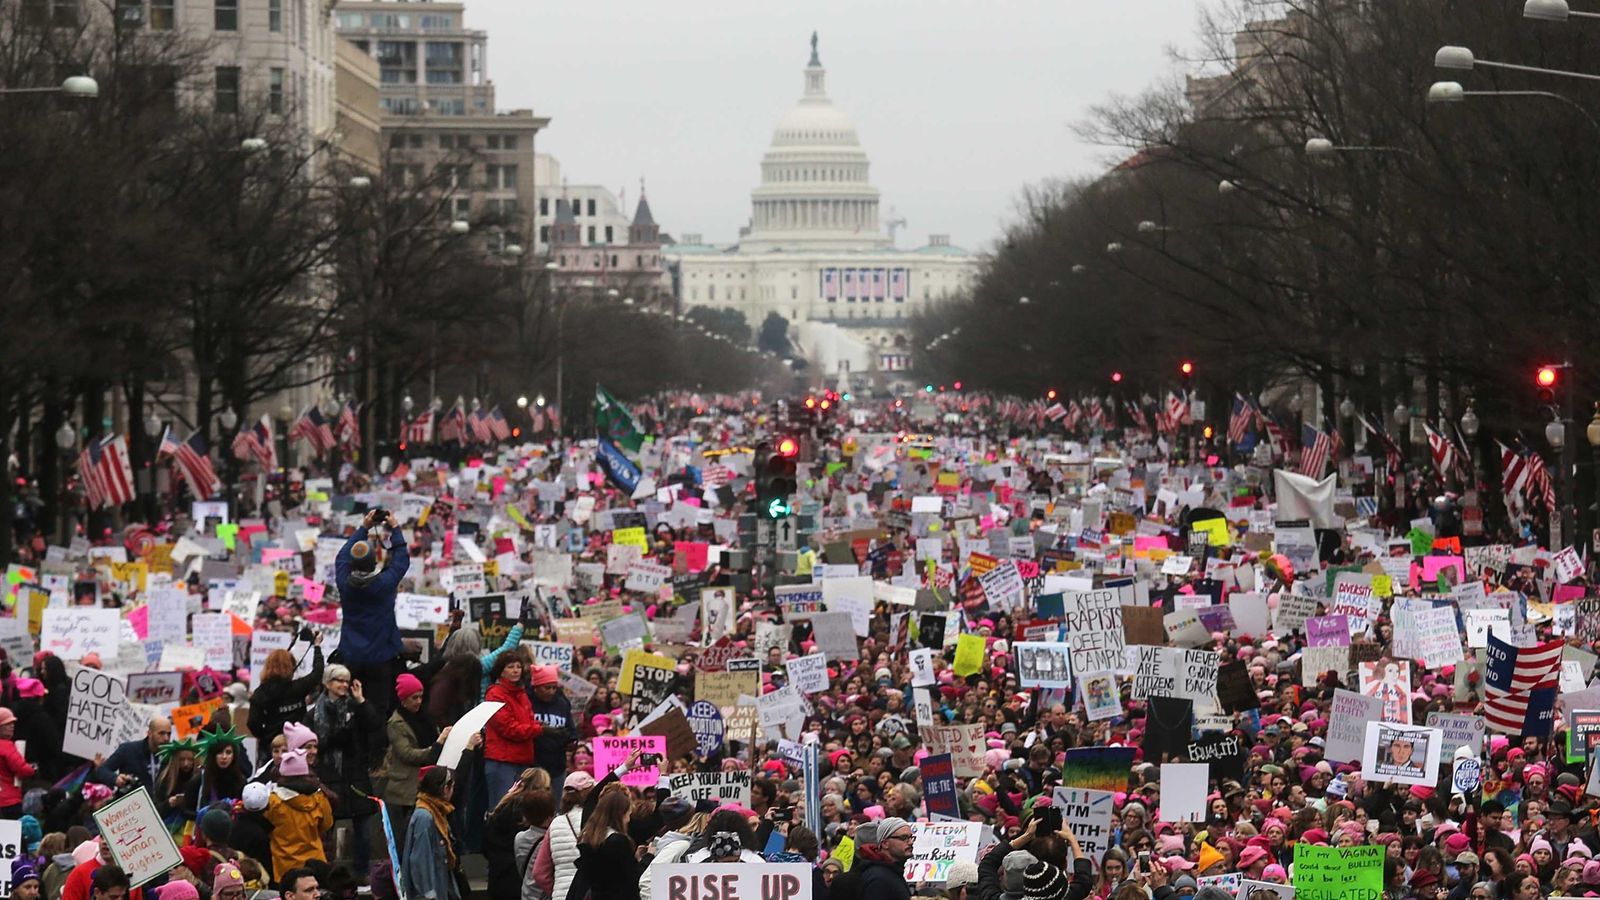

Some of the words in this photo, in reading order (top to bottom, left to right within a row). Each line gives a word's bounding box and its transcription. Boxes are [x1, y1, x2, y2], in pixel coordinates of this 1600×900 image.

[1338, 582, 1372, 595] DIVERSITY
[776, 591, 823, 605] STRONGER
[1076, 591, 1113, 611] KEEP
[1338, 594, 1368, 607] MAKES
[1333, 605, 1368, 618] AMERICA
[1066, 606, 1124, 633] RAPISTS
[1314, 618, 1337, 630] Yes
[1072, 631, 1101, 650] OFF
[1103, 630, 1124, 651] MY
[533, 645, 571, 660] TCHES
[1139, 646, 1163, 663] WE
[1184, 649, 1220, 667] NEVER
[1074, 648, 1128, 673] CAMPUS
[635, 665, 674, 683] STOP
[1136, 662, 1160, 675] ARE
[74, 669, 125, 705] GOD
[1136, 675, 1175, 690] CITIZENS
[1185, 678, 1215, 698] BACK
[691, 701, 717, 717] KEEP
[736, 706, 756, 717] MY
[1439, 719, 1451, 728] MY
[1452, 719, 1470, 730] BODY
[967, 726, 984, 742] WE
[603, 739, 655, 749] WOMENS
[1187, 735, 1239, 762] EQUALITY
[669, 773, 696, 791] KEEP
[696, 772, 722, 787] YOUR
[725, 771, 751, 788] LAWS
[690, 788, 713, 801] OFF
[719, 786, 741, 799] OUR
[1066, 804, 1090, 818] I'M
[1068, 823, 1101, 837] ITH
[1077, 840, 1096, 853] ER
[1338, 848, 1379, 860] VAGINA
[1348, 859, 1382, 870] BULLETS
[668, 873, 741, 900] RISE
[760, 873, 801, 900] UP
